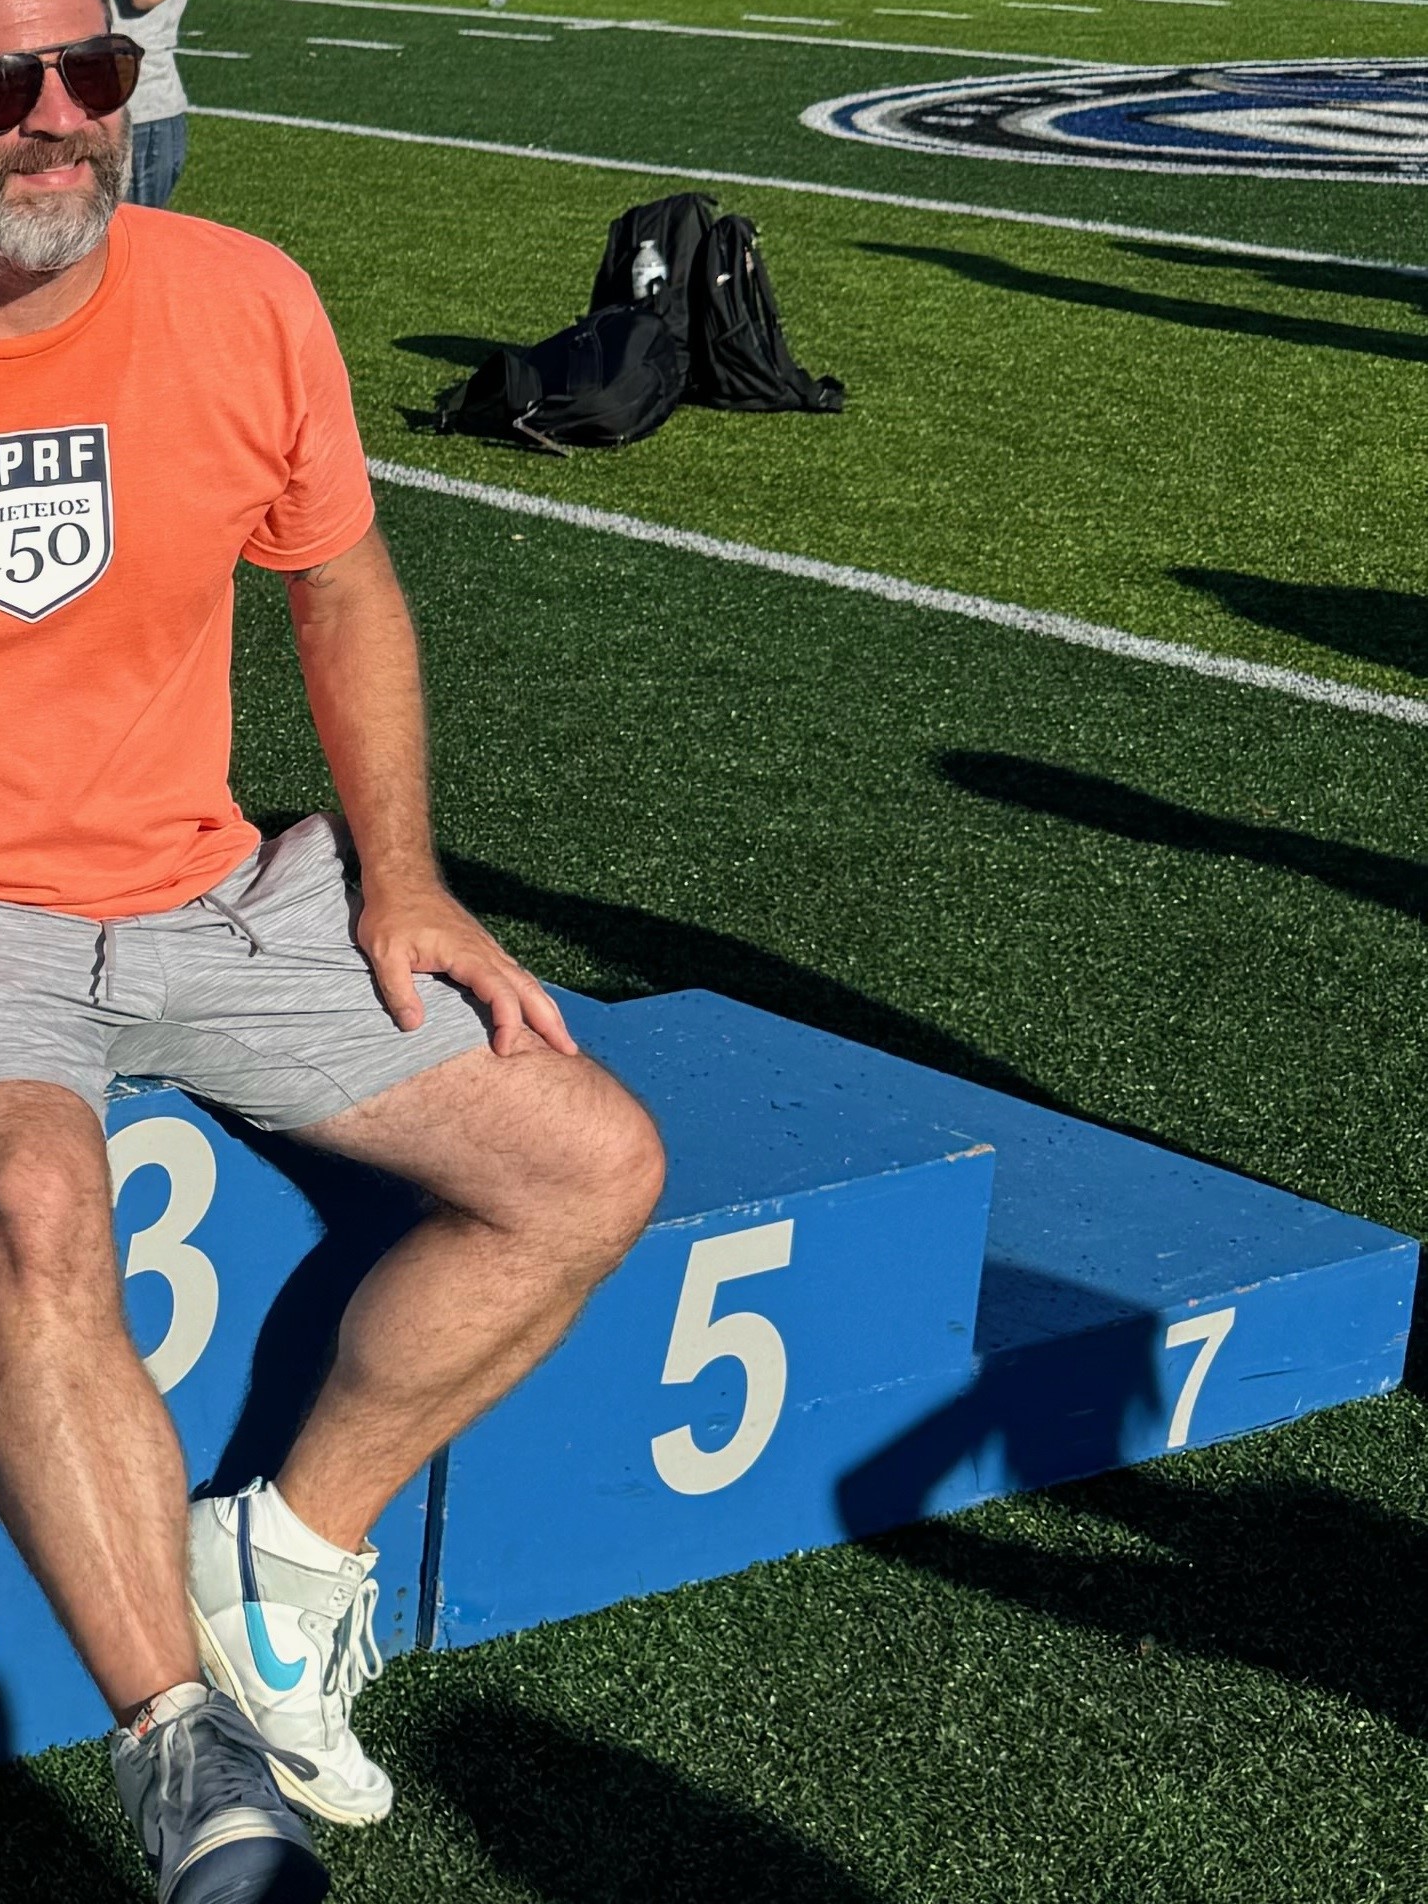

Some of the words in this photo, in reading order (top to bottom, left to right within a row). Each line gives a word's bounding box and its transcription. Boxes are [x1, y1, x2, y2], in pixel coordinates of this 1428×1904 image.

[106, 1116, 219, 1396] 3
[651, 1219, 794, 1496] 5
[1165, 1307, 1236, 1449] 7
